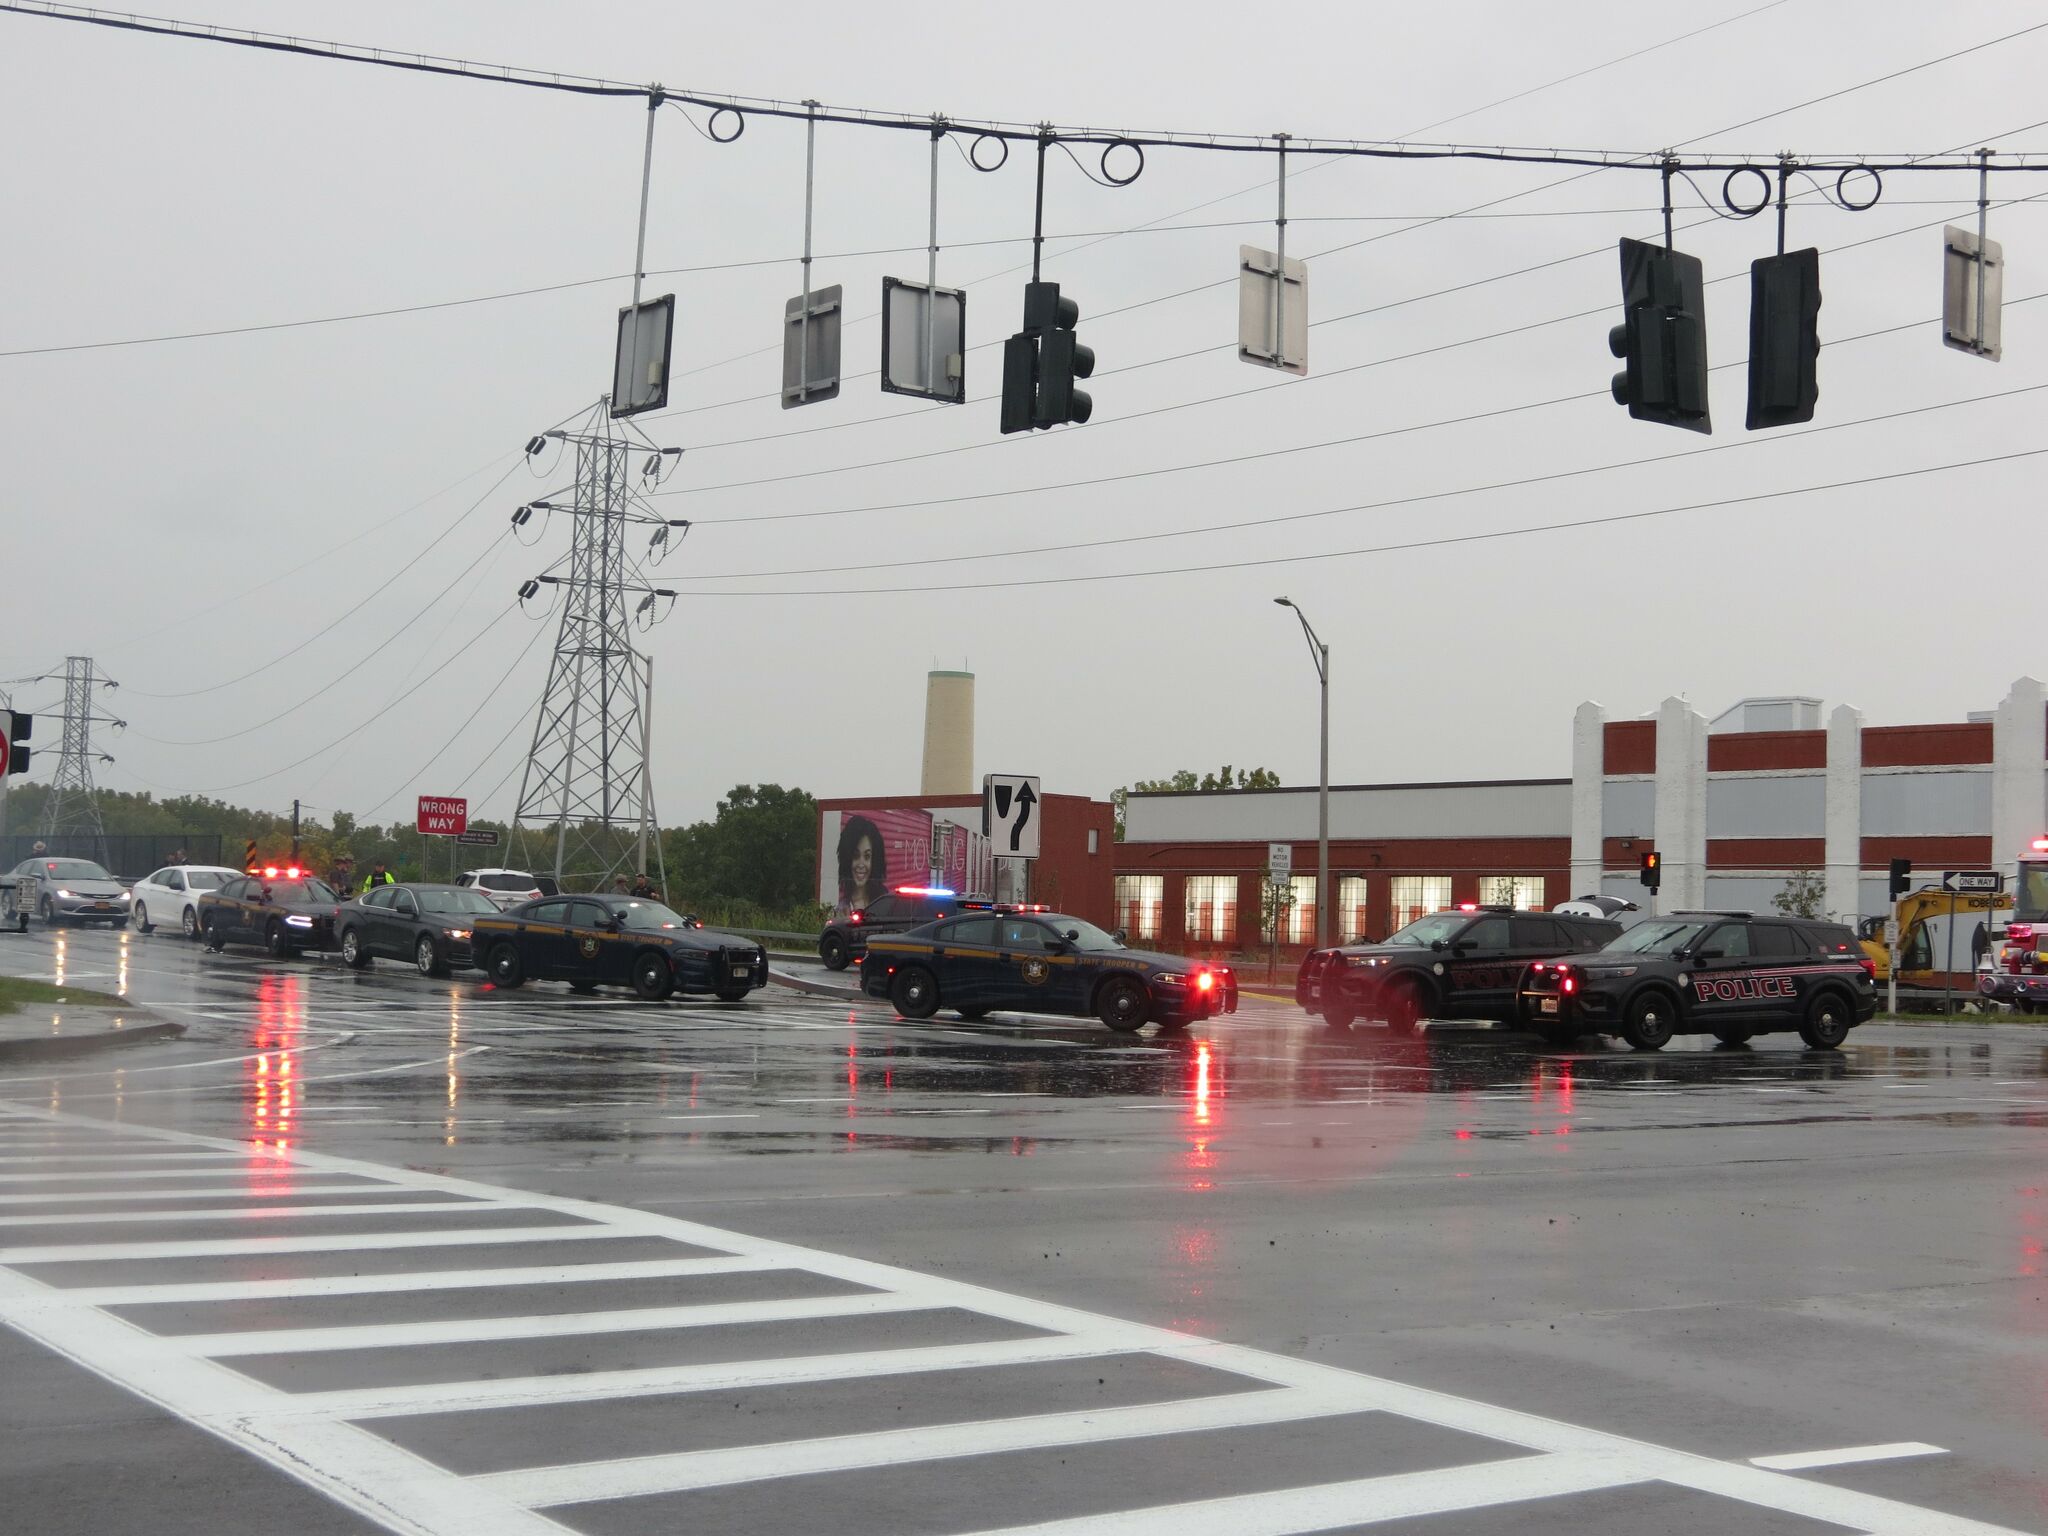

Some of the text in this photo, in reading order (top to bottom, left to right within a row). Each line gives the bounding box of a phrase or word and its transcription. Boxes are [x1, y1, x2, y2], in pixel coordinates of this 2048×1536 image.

[420, 801, 465, 815] WRONG
[428, 817, 456, 830] WAY
[904, 838, 965, 871] MOVNG
[1959, 877, 1994, 887] ONE WAY
[1968, 898, 2005, 908] KOBECO
[1078, 957, 1136, 969] STATE TROOPER
[1694, 977, 1797, 1002] POLICE
